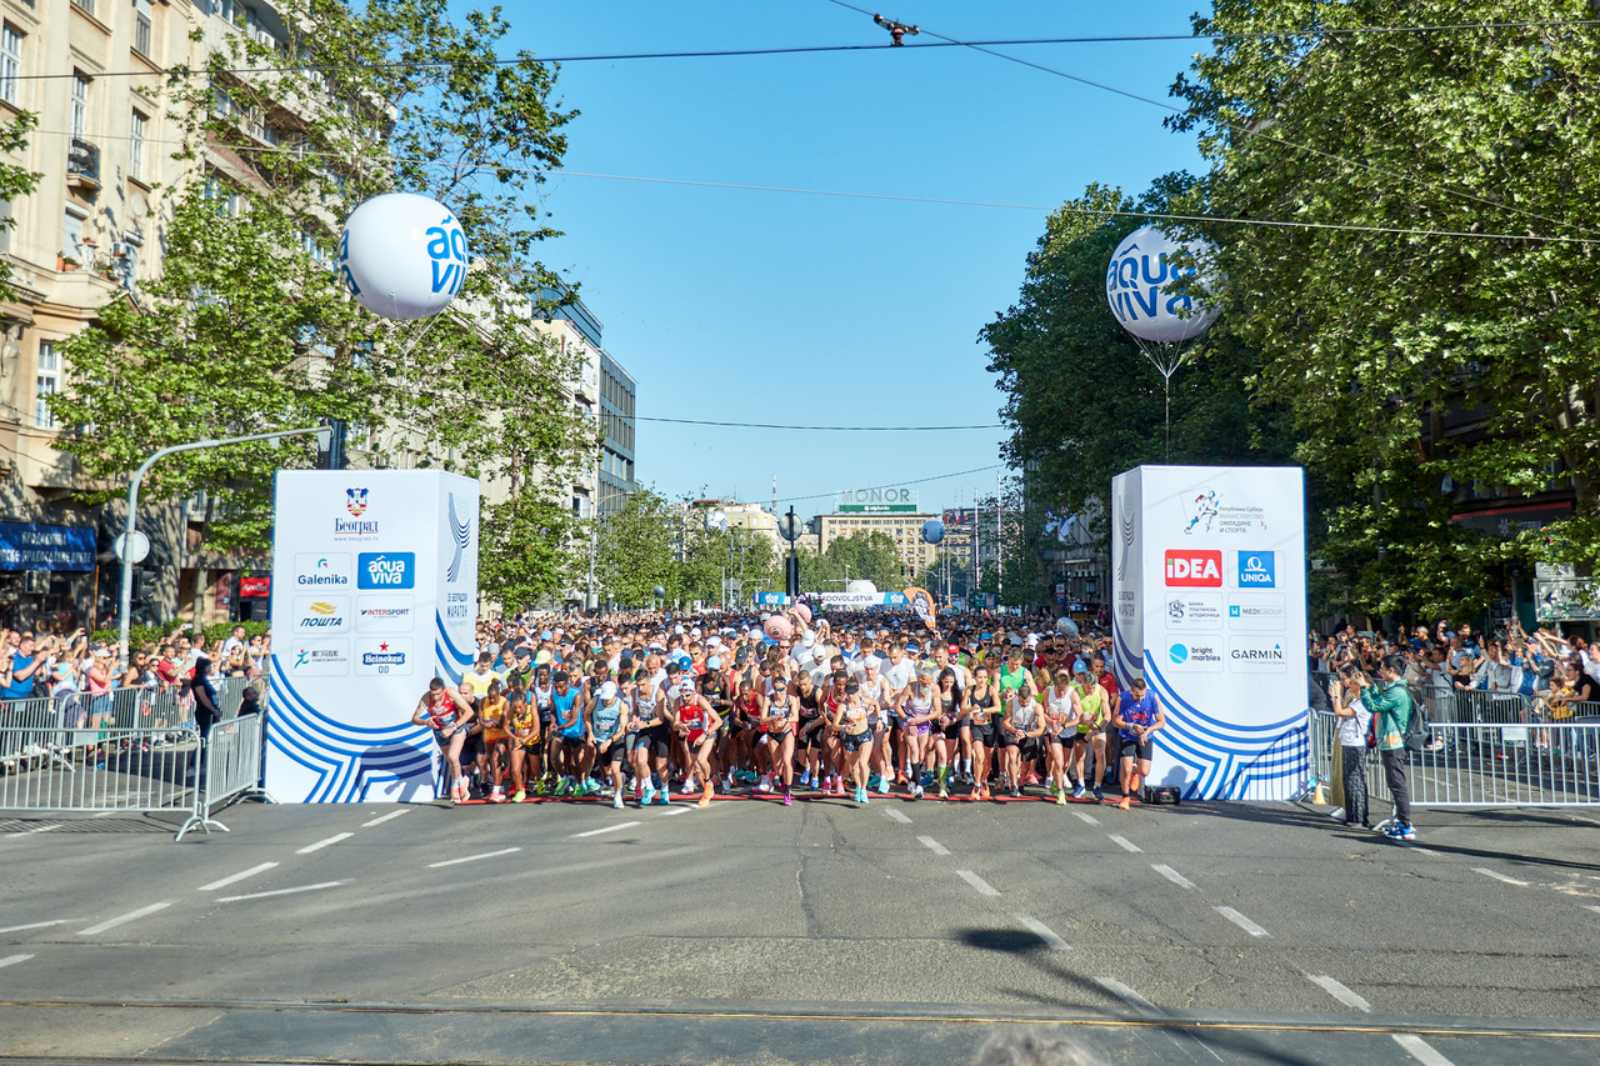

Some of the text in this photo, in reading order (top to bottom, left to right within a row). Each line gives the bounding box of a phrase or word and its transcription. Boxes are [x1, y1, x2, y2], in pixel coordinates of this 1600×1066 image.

[298, 574, 348, 585] Galenika
[371, 571, 402, 585] viva
[1240, 574, 1272, 583] UNIQA
[367, 608, 409, 616] INTERSPORT
[300, 617, 343, 627] ПОШТА
[365, 654, 403, 663] Heineken
[1231, 649, 1282, 660] GARMIN
